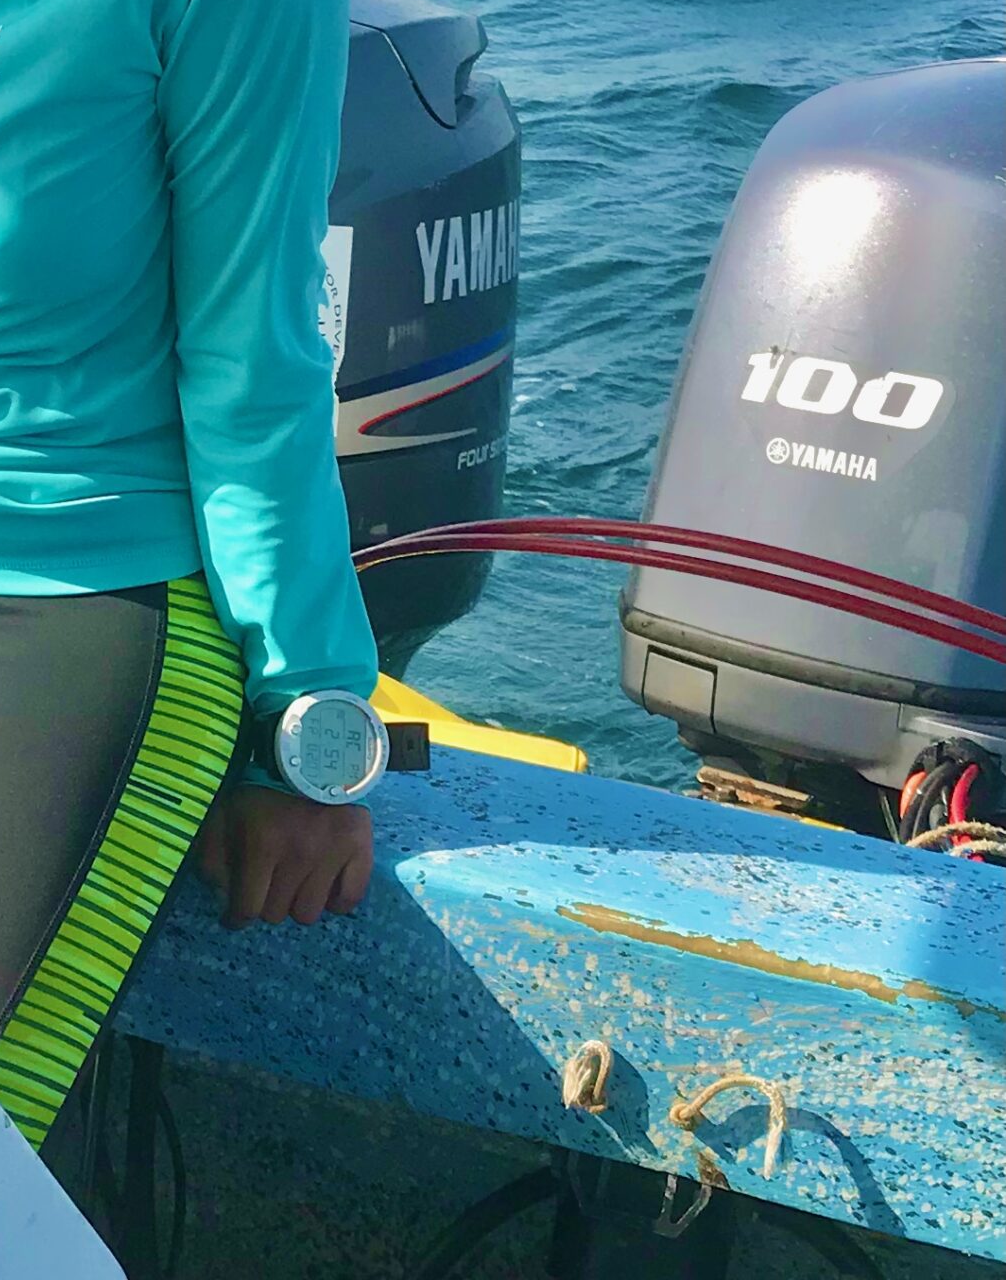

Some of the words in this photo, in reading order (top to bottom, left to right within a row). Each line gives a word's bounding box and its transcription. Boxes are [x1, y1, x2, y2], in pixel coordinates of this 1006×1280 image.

[416, 200, 520, 304] YAMAH
[325, 266, 339, 298] OR
[333, 304, 343, 360] DEVE
[741, 352, 944, 430] 100
[792, 442, 878, 482] YAMAHA
